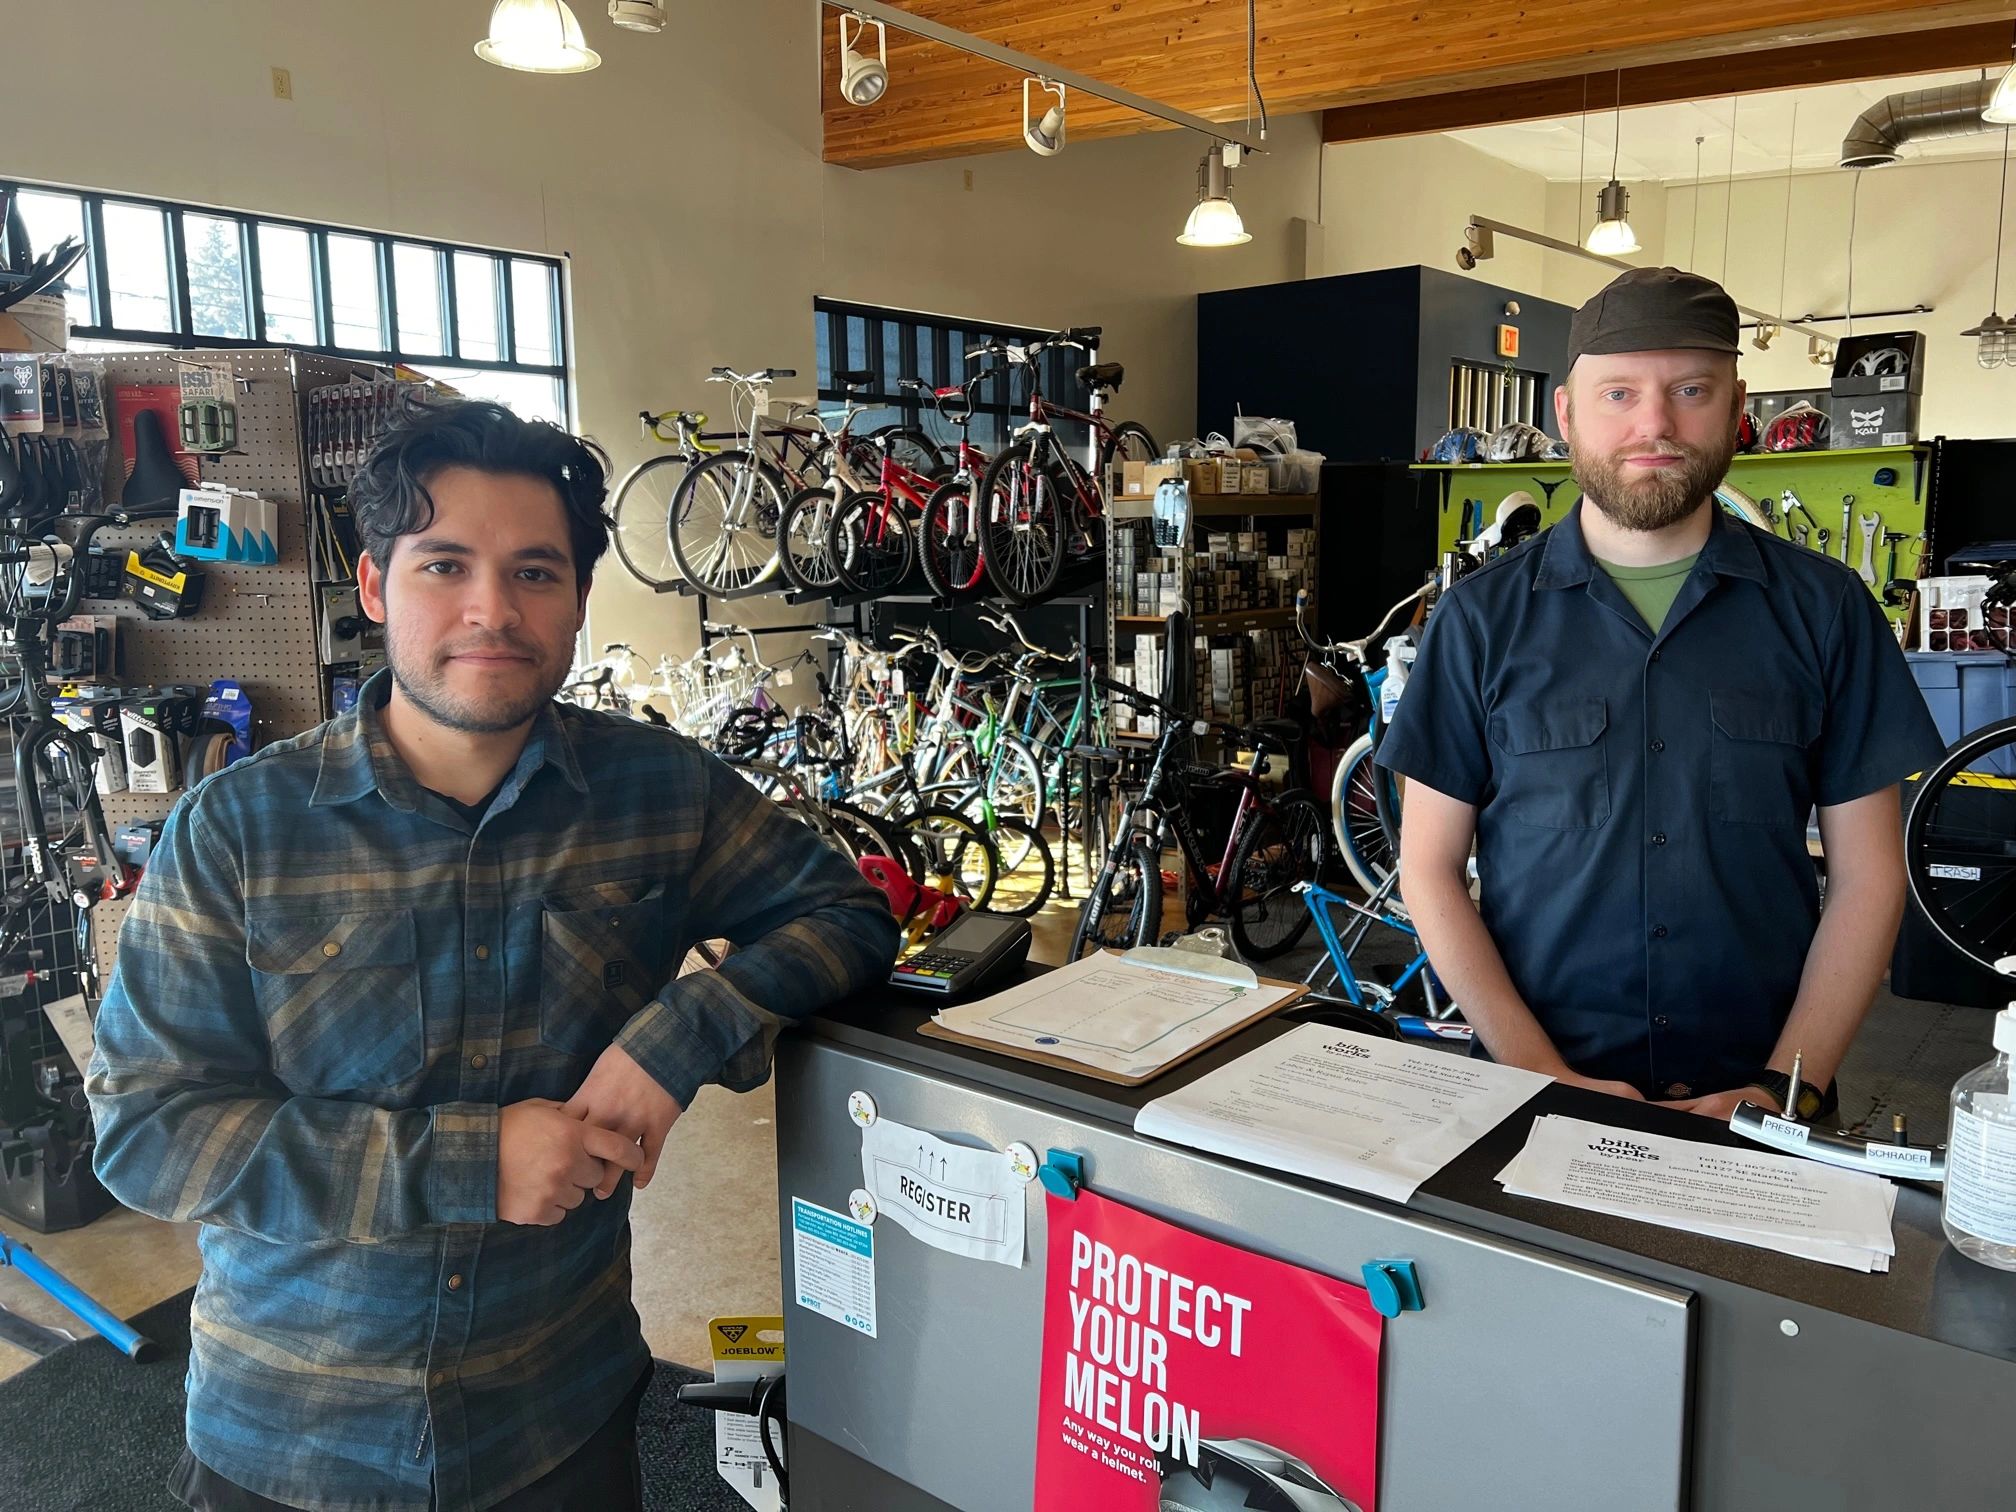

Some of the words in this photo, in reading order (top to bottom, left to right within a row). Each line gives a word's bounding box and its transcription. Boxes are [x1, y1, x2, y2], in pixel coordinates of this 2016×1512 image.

[182, 388, 214, 396] SAFARI
[1855, 427, 1879, 436] KALI
[126, 711, 157, 728] vittoria
[1933, 865, 1978, 880] TRASH
[1322, 1044, 1372, 1059] works
[1335, 1041, 1371, 1053] bike
[1764, 1119, 1805, 1140] PRESTA
[1587, 1143, 1660, 1161] works
[1600, 1137, 1650, 1152] bike
[1868, 1147, 1928, 1165] SCHRADER
[1699, 1163, 1733, 1172] 14127
[1750, 1171, 1782, 1181] Stark
[899, 1174, 972, 1224] REGISTER
[797, 1206, 842, 1229] TRANSPORTATION
[842, 1223, 868, 1238] HOTLINES
[1069, 1230, 1253, 1359] PROTECT
[1067, 1290, 1169, 1393] YOUR
[1063, 1350, 1201, 1469] MELON
[1061, 1415, 1085, 1440] Any
[1086, 1426, 1111, 1452] way
[1112, 1436, 1137, 1462] you
[1138, 1445, 1165, 1477] roll,
[1061, 1433, 1090, 1458] wear
[1090, 1447, 1100, 1461] a
[1100, 1445, 1147, 1484] helmet.
